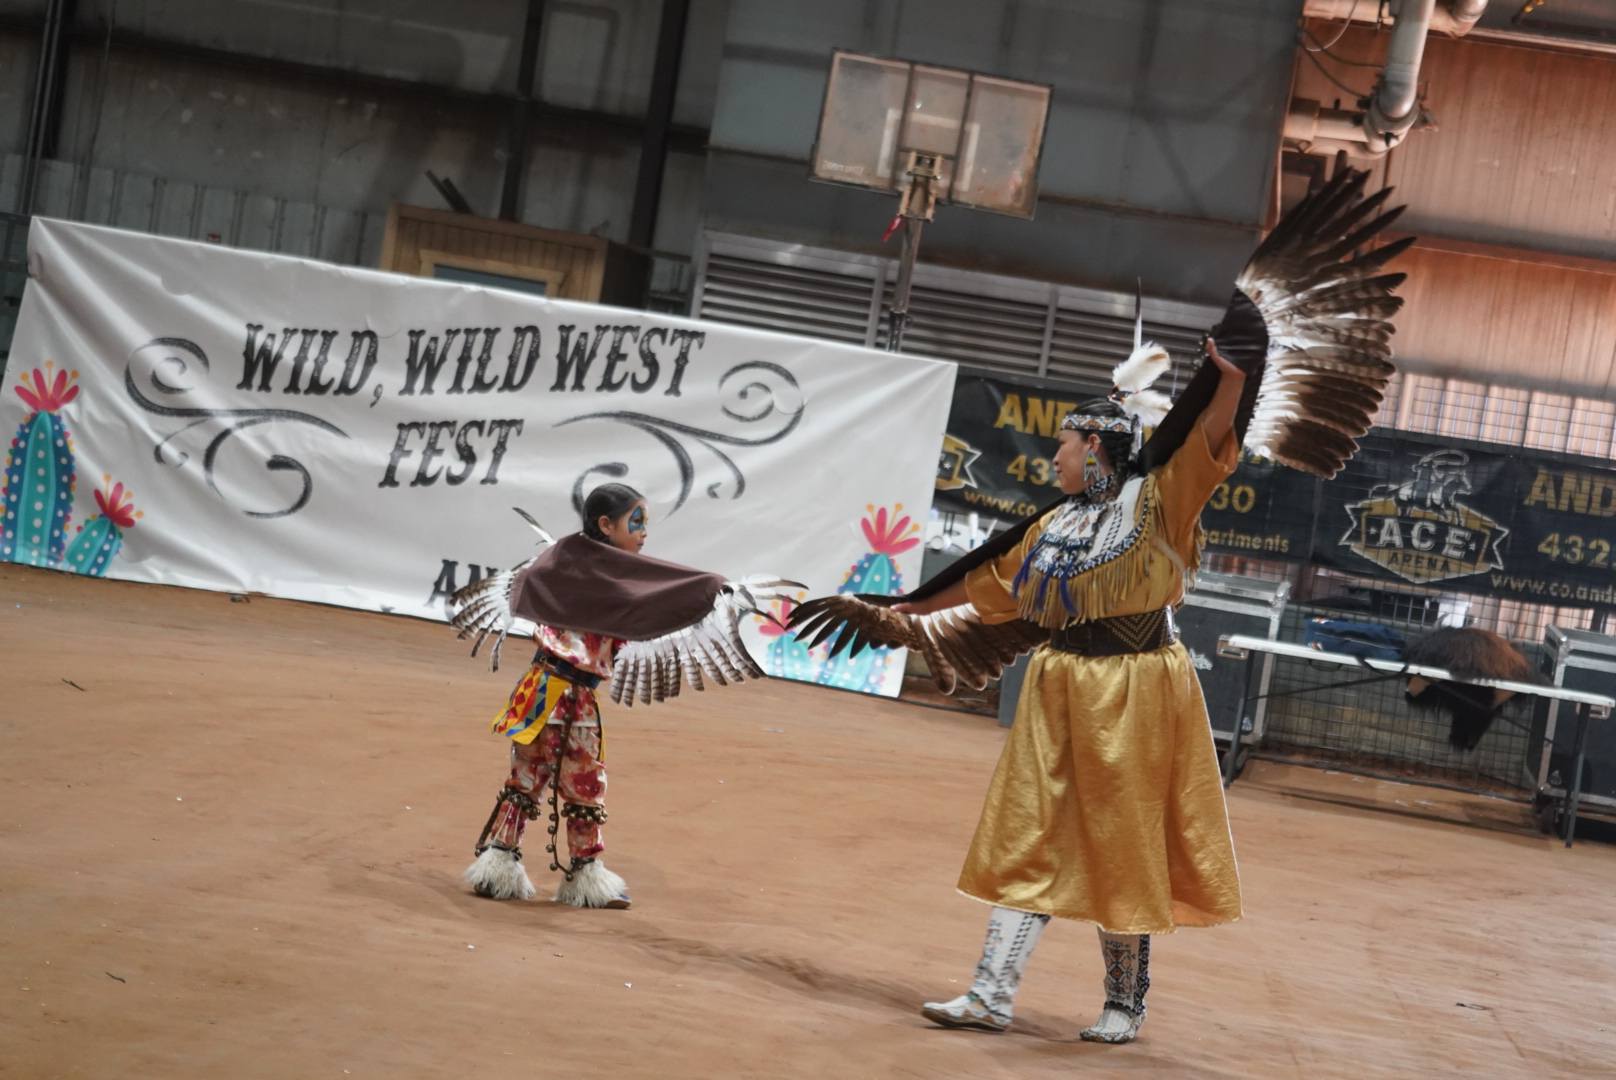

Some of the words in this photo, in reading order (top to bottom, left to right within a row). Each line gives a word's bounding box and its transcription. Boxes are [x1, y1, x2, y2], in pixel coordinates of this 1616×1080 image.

[236, 323, 383, 407] WILD,
[399, 325, 540, 396] WILD
[550, 324, 705, 396] WEST
[378, 419, 524, 487] FEST
[1203, 529, 1289, 552] artments
[1376, 518, 1471, 558] ACE
[1387, 553, 1450, 572] ARENA
